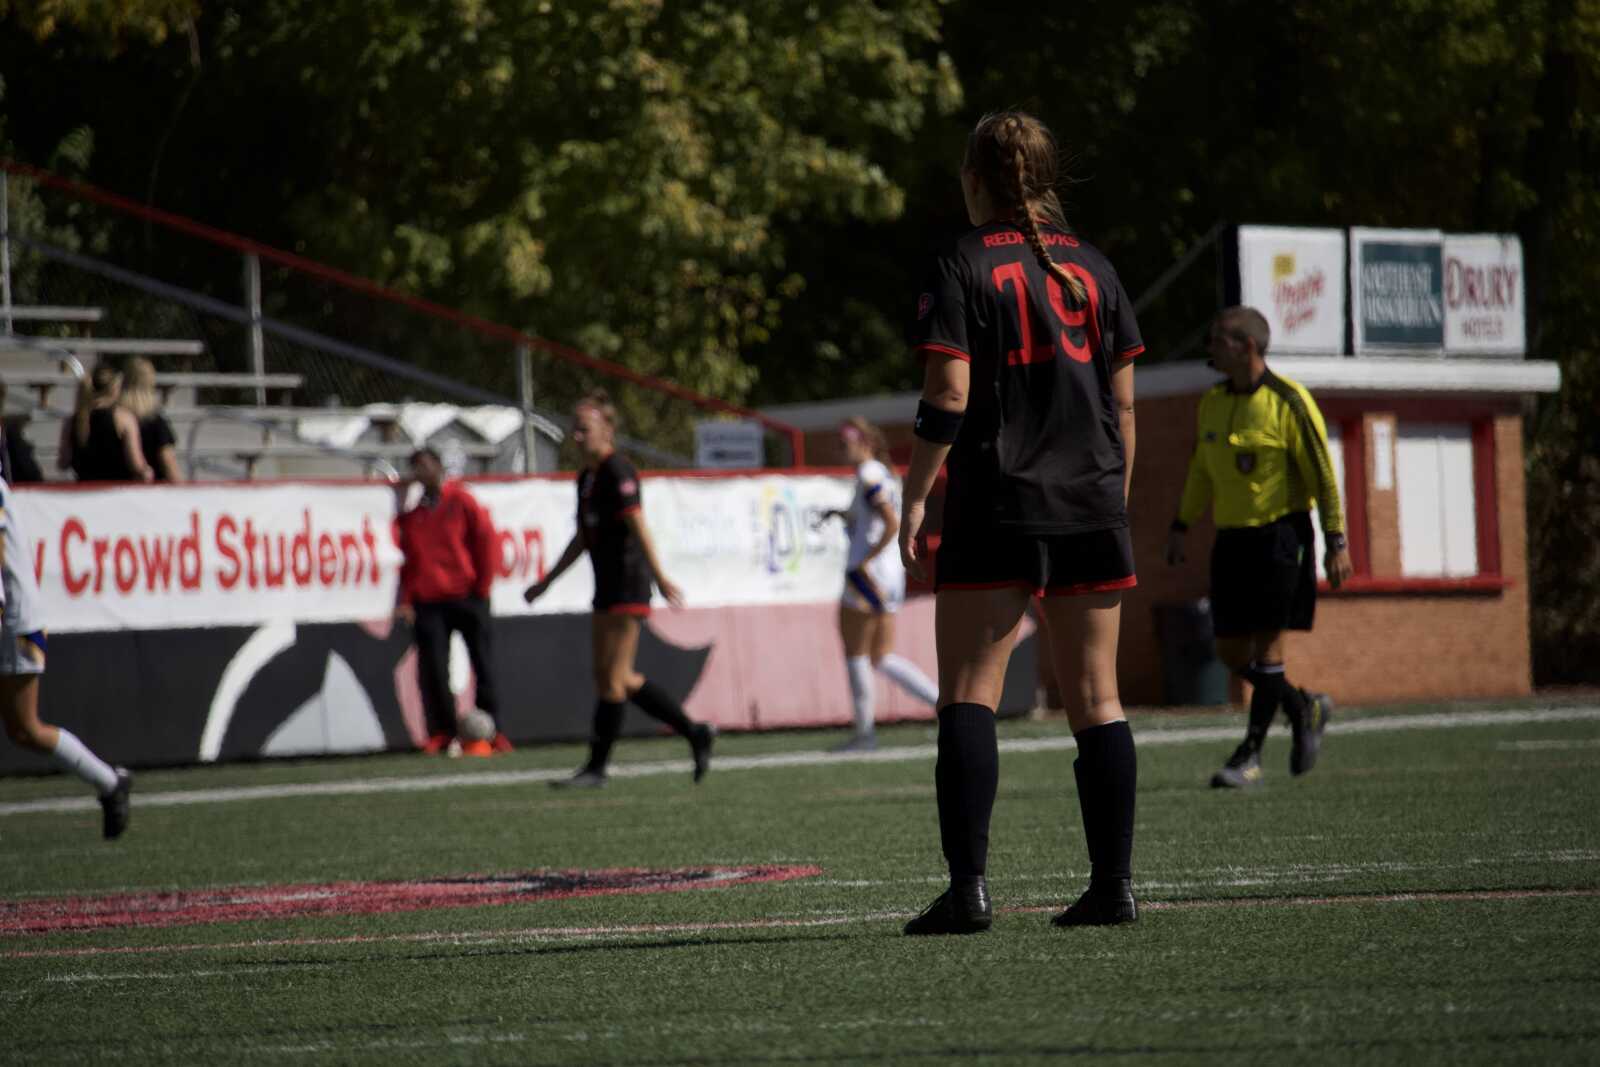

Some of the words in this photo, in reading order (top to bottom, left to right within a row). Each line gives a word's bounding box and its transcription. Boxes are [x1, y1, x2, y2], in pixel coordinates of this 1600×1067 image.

[992, 261, 1101, 365] 19
[60, 508, 201, 598] Crowd
[215, 508, 381, 590] Student
